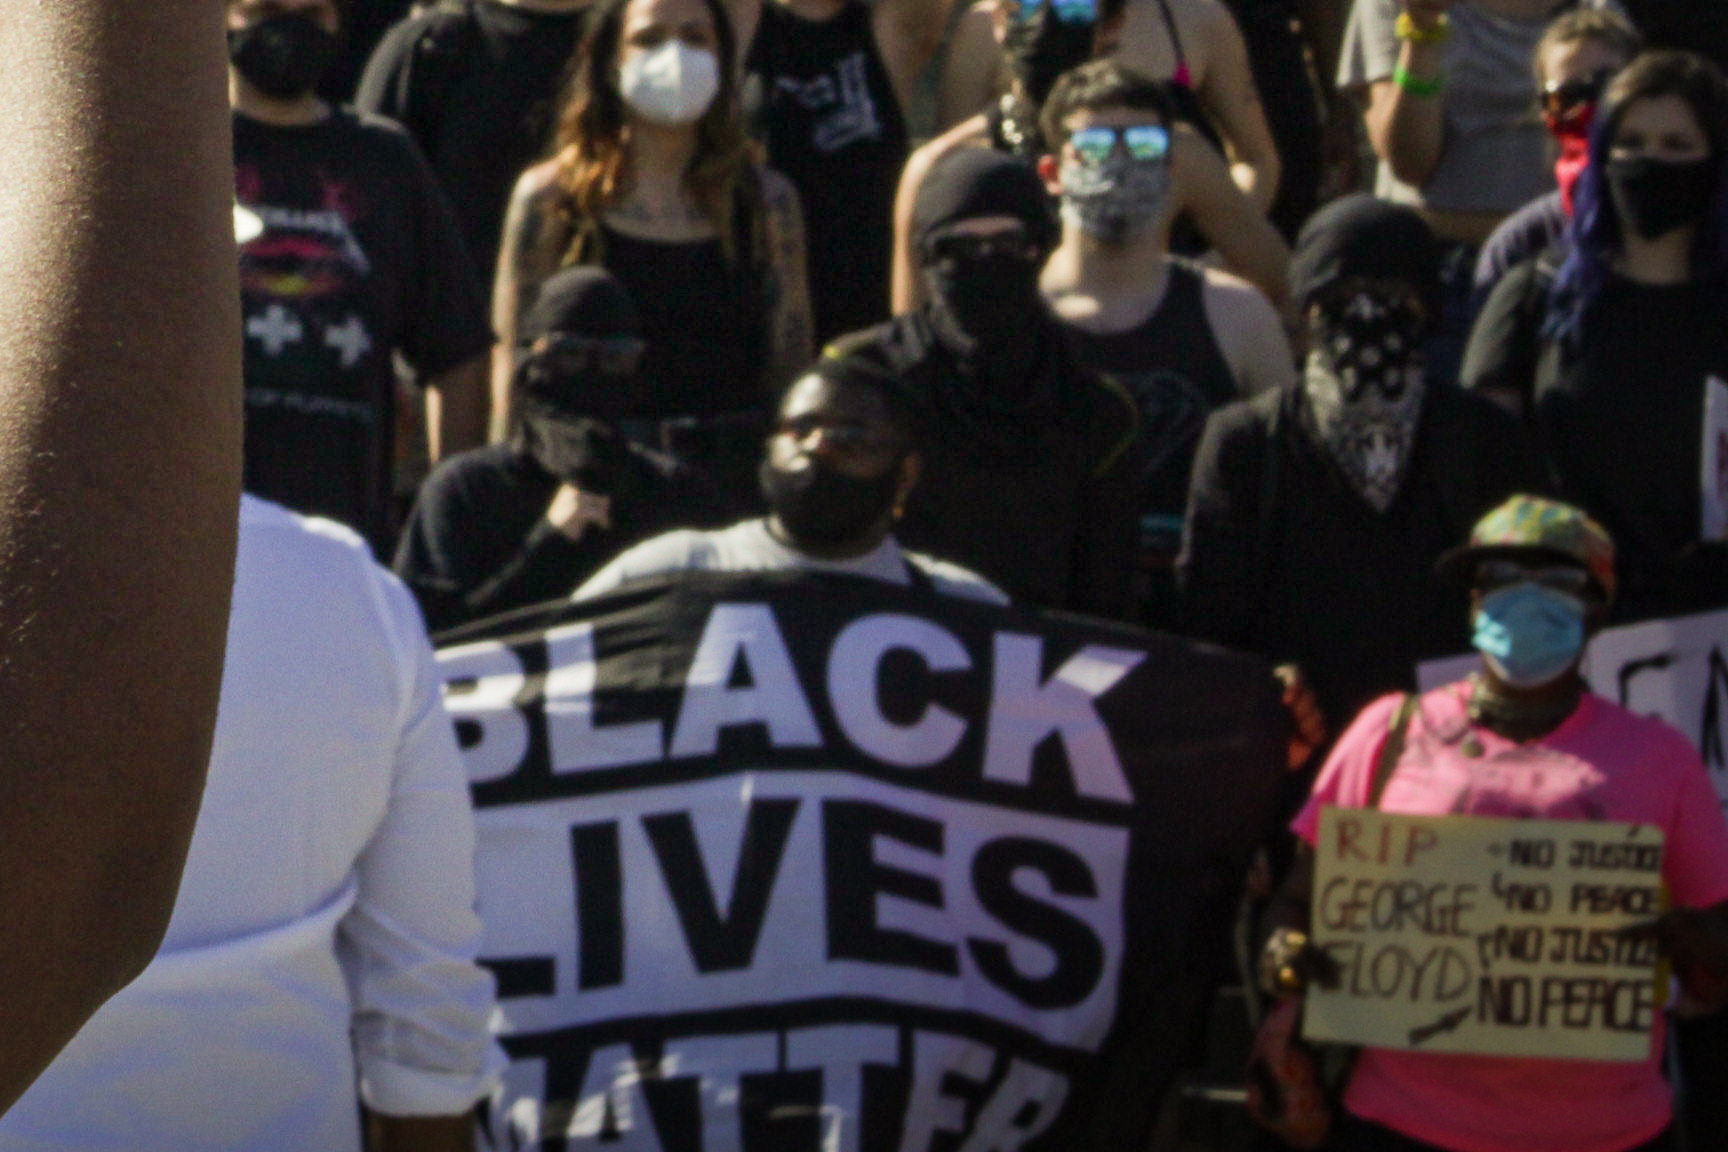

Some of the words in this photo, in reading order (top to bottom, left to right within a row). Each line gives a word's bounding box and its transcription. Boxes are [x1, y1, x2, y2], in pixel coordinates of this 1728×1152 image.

[434, 603, 1148, 805] BLACK
[1335, 818, 1439, 867] RIP
[1509, 838, 1556, 869] NO
[1319, 875, 1478, 938] GEORGE
[1476, 975, 1531, 1028] NO
